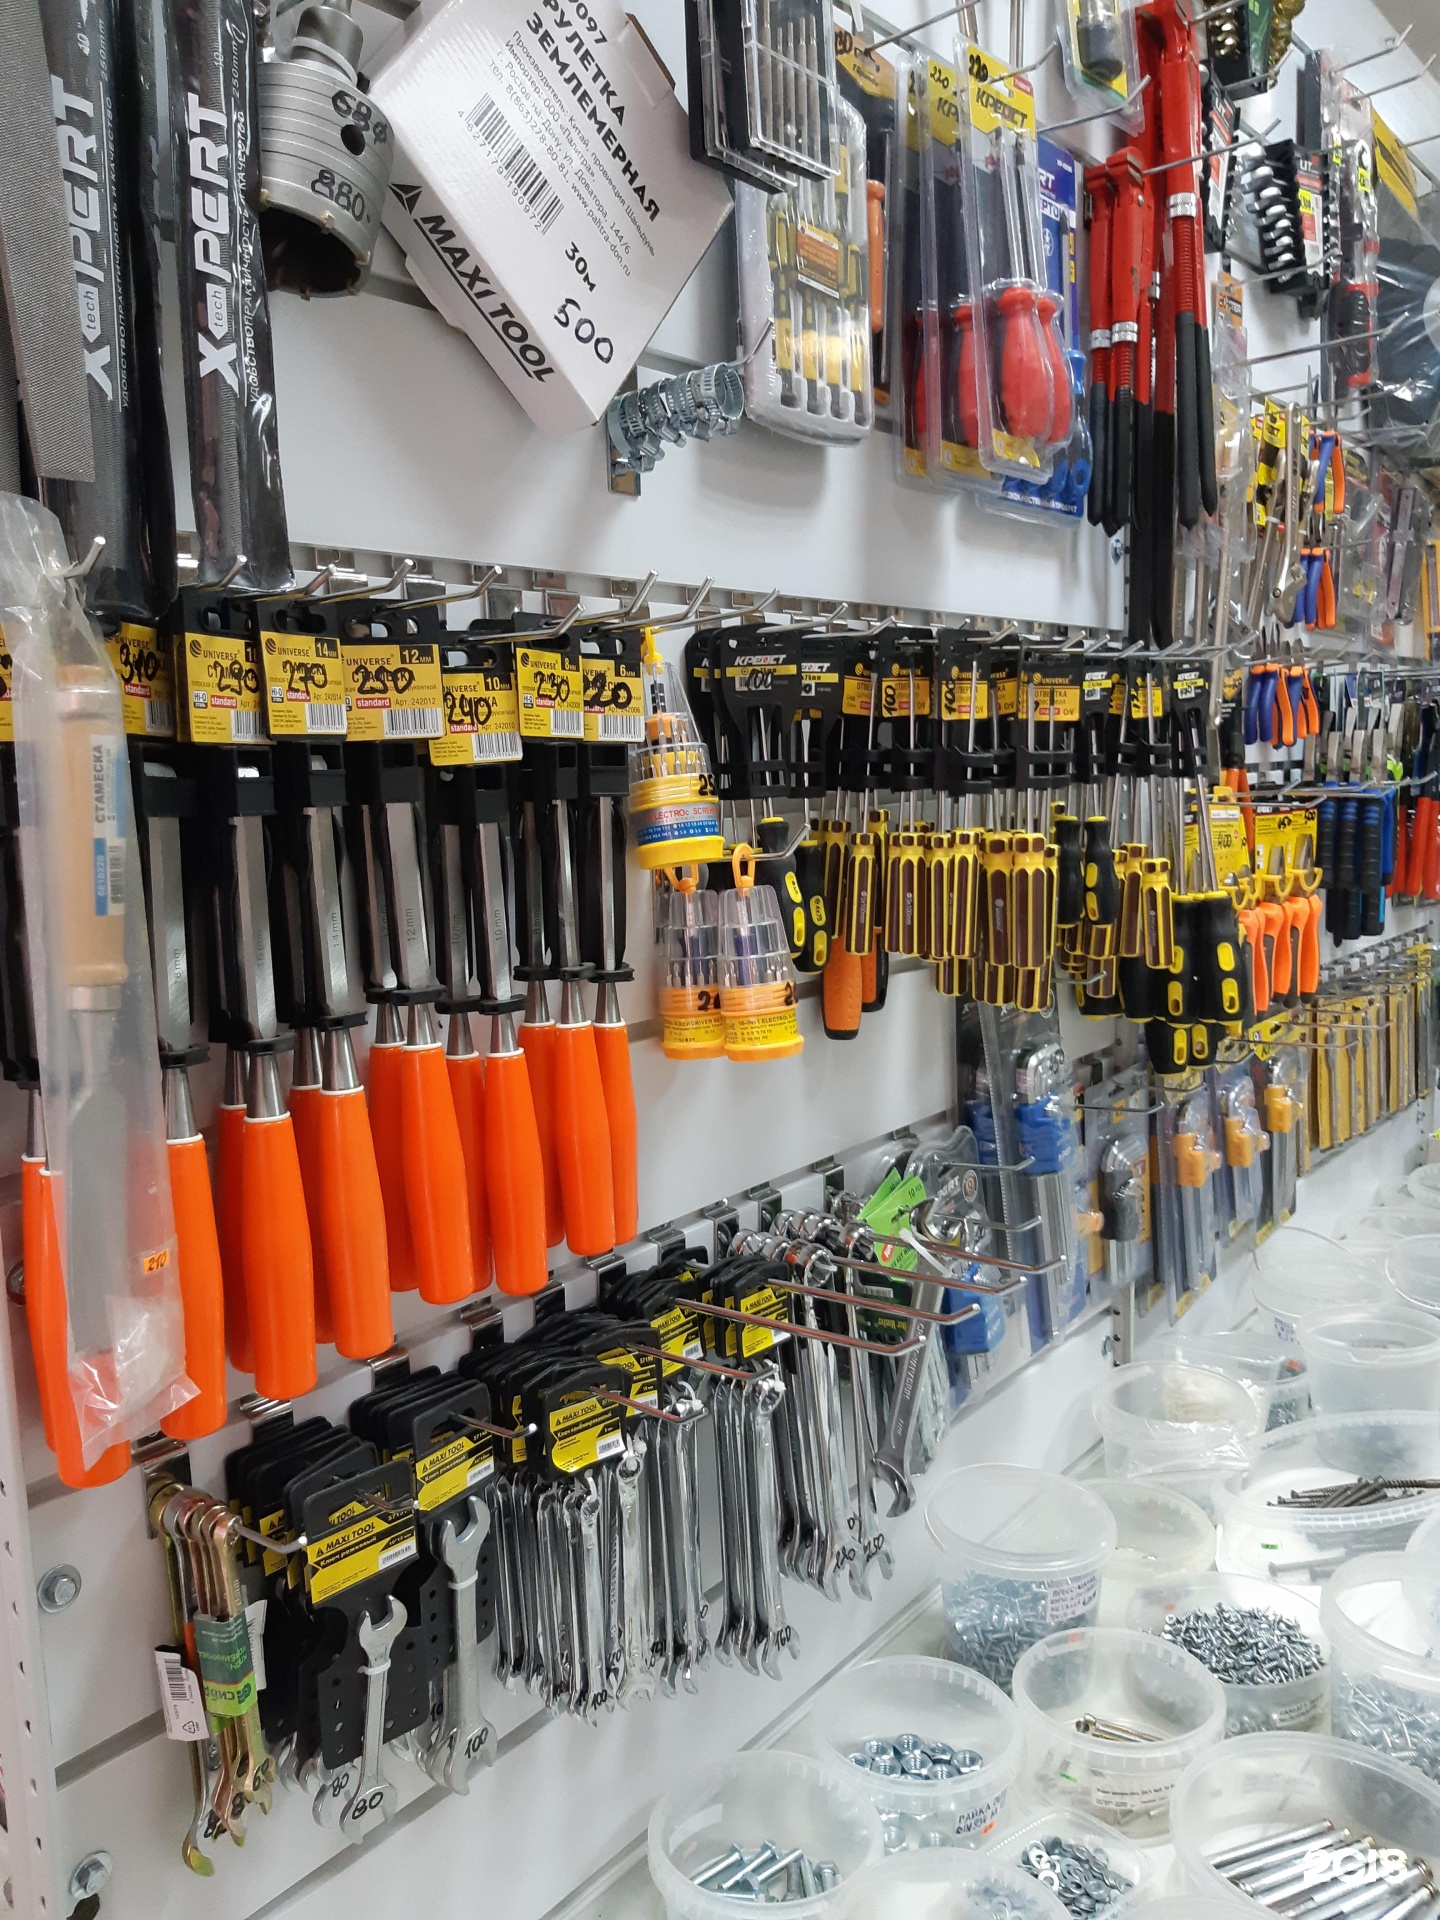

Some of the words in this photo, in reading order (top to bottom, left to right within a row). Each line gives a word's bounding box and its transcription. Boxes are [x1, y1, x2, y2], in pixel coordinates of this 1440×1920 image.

[505, 40, 544, 98] Импортер:
[543, 0, 625, 127] РУЛЕТКА
[512, 30, 570, 117] Производитель:
[568, 115, 590, 152] Китай,
[590, 151, 626, 207] провинция
[526, 11, 660, 222] ЗЕМЛЕМЕРНАЯ
[106, 97, 117, 182] КАЧЕСТВО
[610, 221, 630, 255] 144/6
[85, 289, 96, 330] tech
[213, 290, 224, 329] tech
[420, 214, 497, 300] MAXI
[488, 302, 555, 383] TOOL
[553, 298, 614, 364] 500
[203, 648, 239, 661] UNIVERSE
[277, 647, 311, 658] UNIVERSE
[346, 657, 392, 666] UNIVERSE
[531, 661, 557, 670] UNIVERSE
[211, 696, 237, 707] standard
[357, 698, 390, 707] standard
[411, 697, 436, 706] 242012
[92, 744, 107, 824] СТАМЕСКА
[147, 1250, 168, 1271] 210
[562, 1409, 580, 1422] MAXI
[580, 1403, 597, 1415] TOOL
[429, 1451, 447, 1468] MAXI
[447, 1440, 465, 1456] TOOL
[320, 1554, 340, 1567] Ключ
[340, 1535, 377, 1559] рожковый
[326, 1533, 350, 1551] MAXI
[352, 1522, 376, 1539] TOOL
[463, 1726, 488, 1760] 100
[352, 1791, 384, 1821] 80
